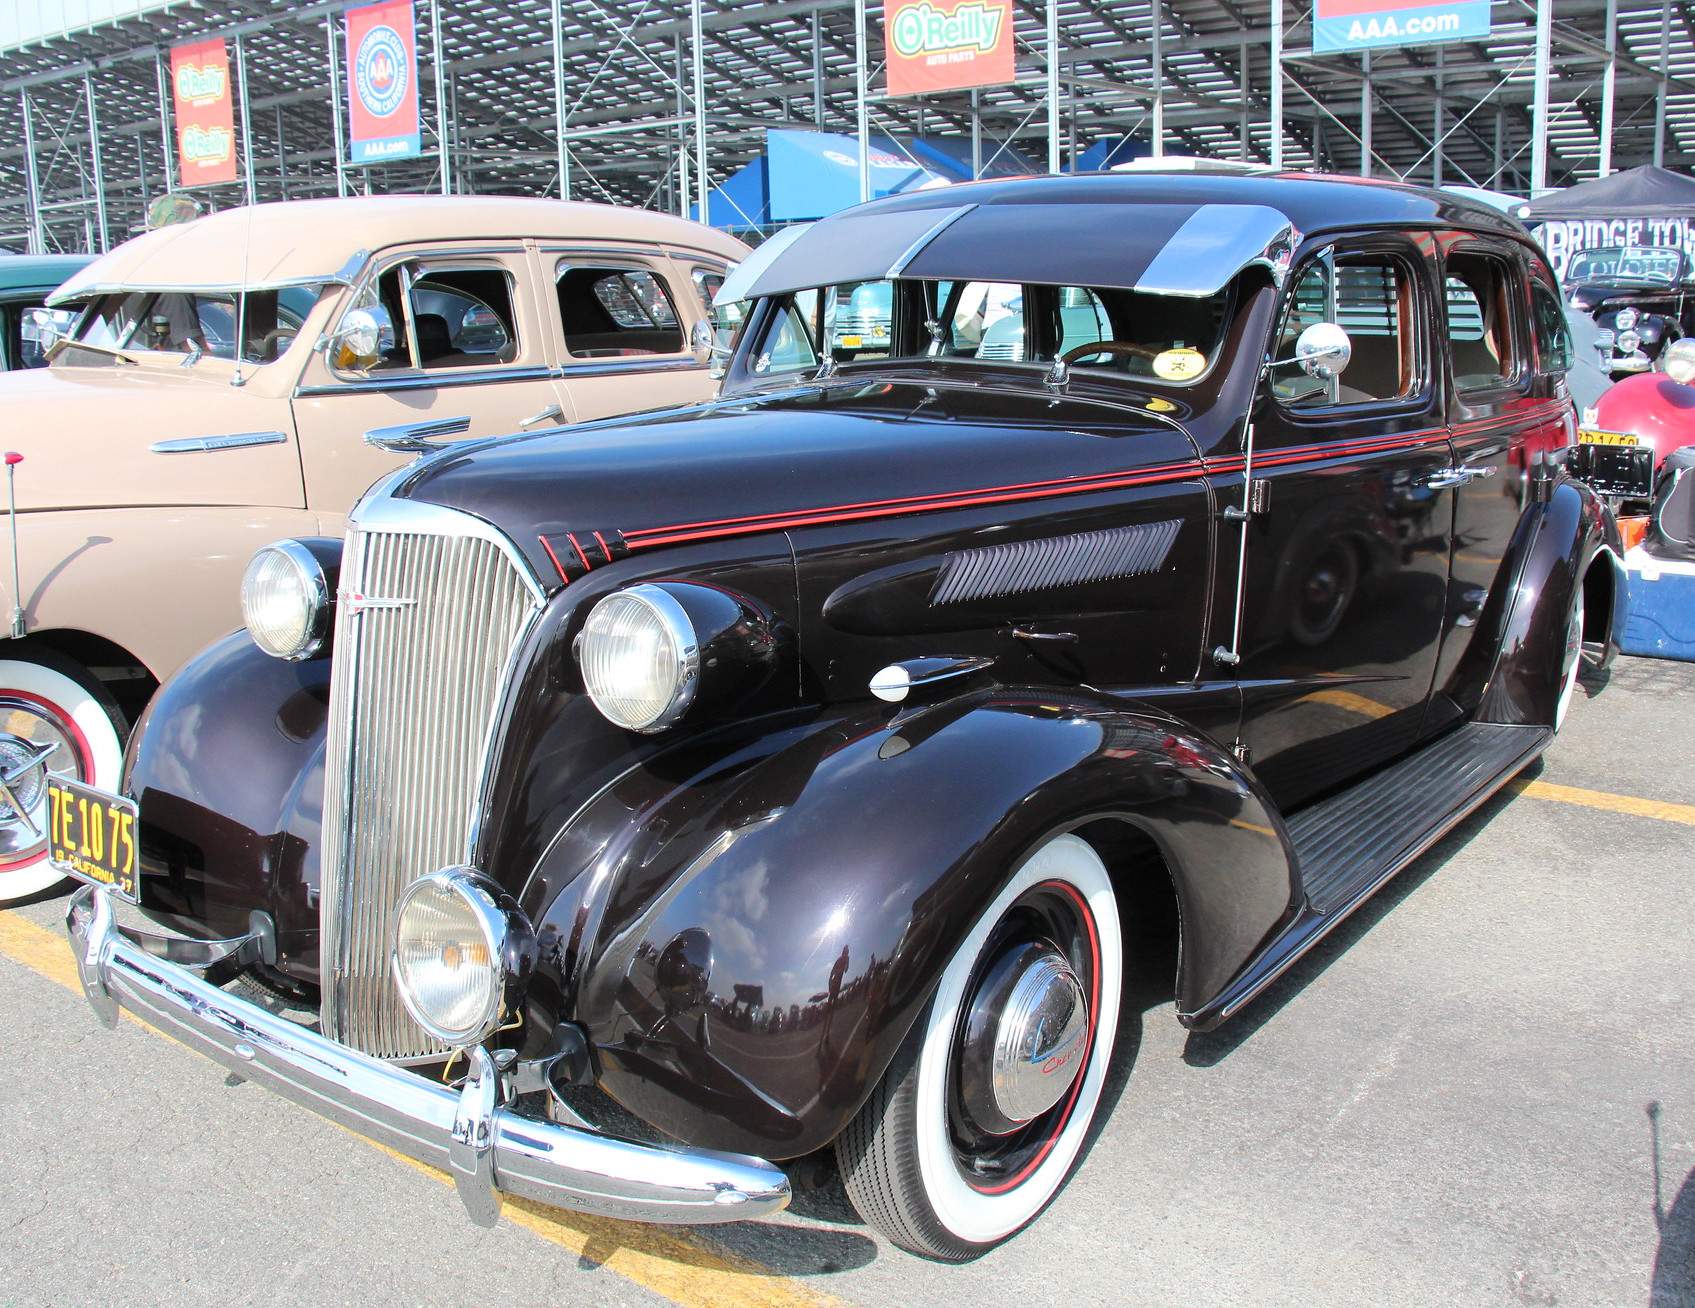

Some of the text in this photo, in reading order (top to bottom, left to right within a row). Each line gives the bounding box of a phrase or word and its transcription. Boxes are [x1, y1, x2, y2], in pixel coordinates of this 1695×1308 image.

[893, 3, 1003, 55] O'Reilly
[1347, 13, 1460, 41] AAA.com
[178, 64, 225, 101] O'Reilly
[370, 57, 394, 81] AAA
[364, 140, 409, 157] AAA.com
[1545, 219, 1643, 284] BRIDGE
[48, 786, 134, 875] 7E 10 75
[68, 854, 115, 884] CALIFORNIA
